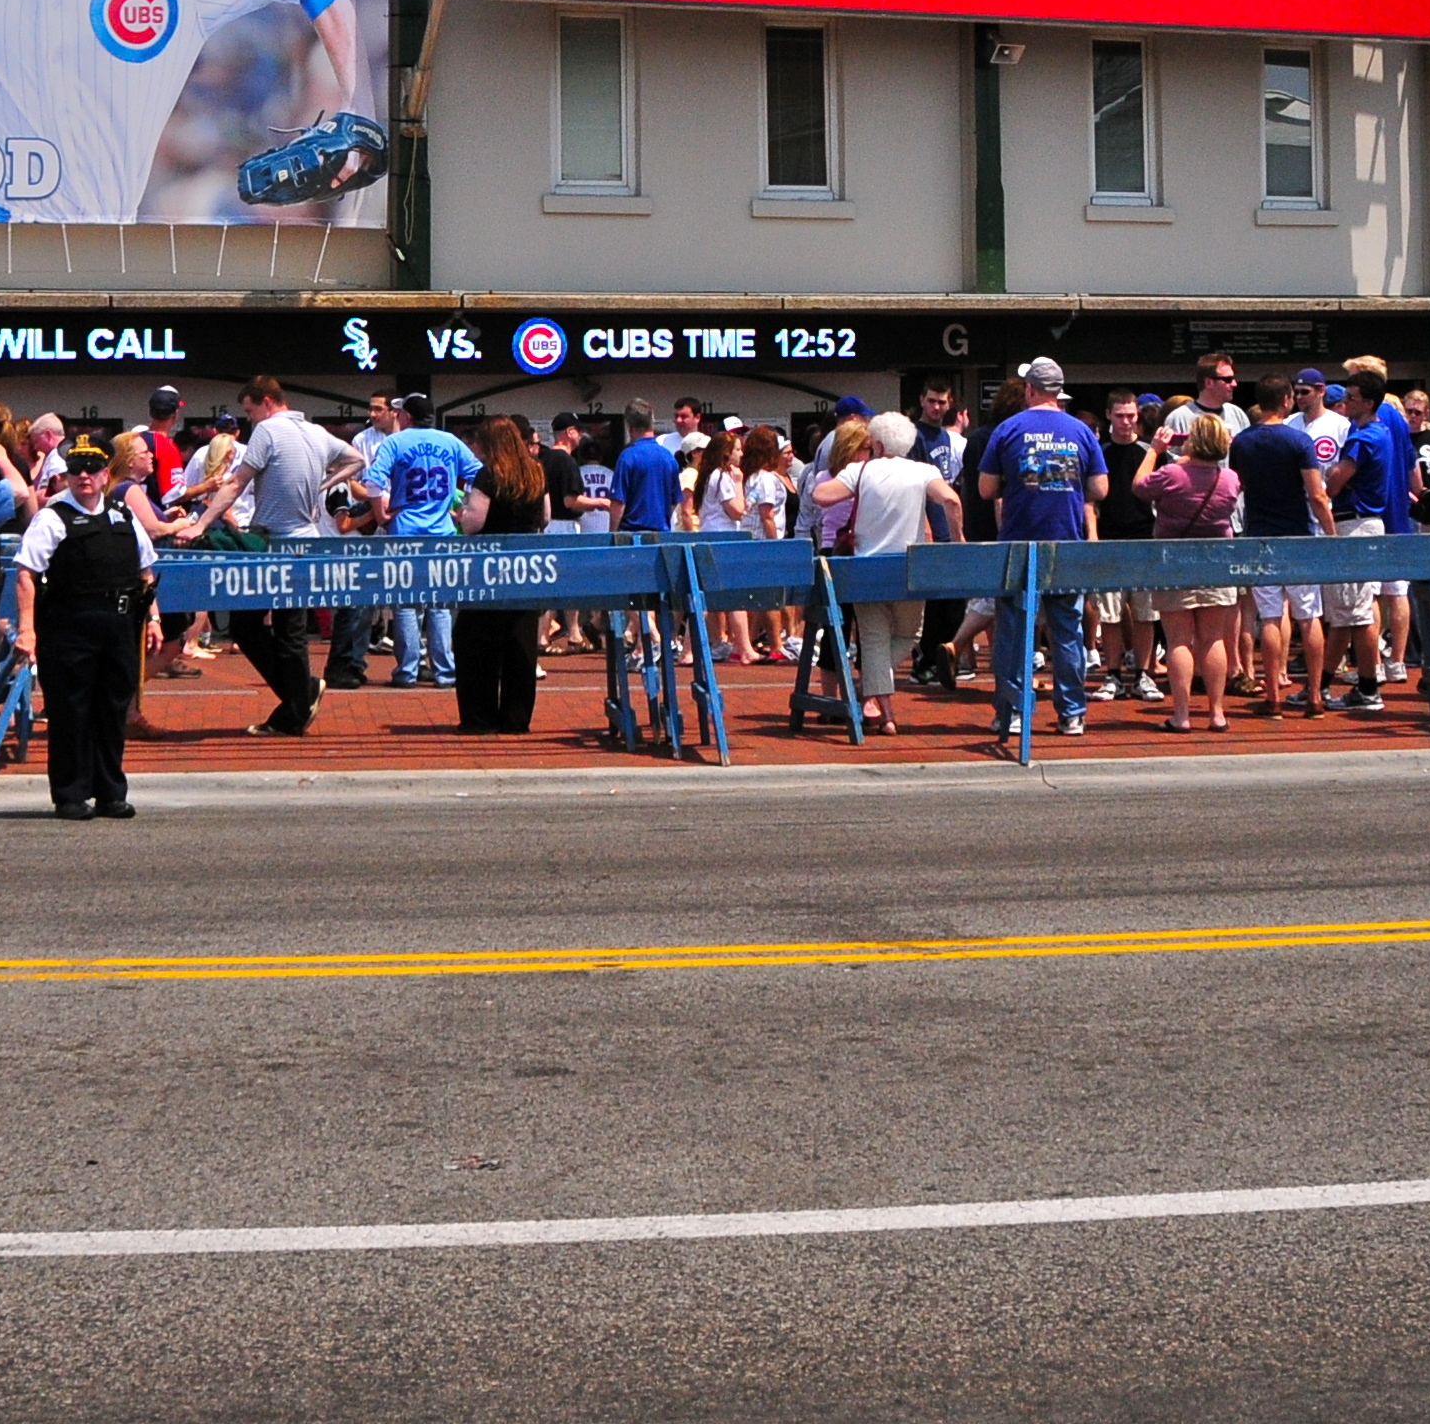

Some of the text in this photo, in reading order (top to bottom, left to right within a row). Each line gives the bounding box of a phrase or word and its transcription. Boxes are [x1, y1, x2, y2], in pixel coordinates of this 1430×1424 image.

[86, 328, 186, 360] CALL
[426, 328, 482, 360] VS.
[583, 328, 857, 359] CUBS TIME 12:52
[942, 323, 969, 356] G
[81, 406, 99, 419] 16
[470, 403, 487, 417] 13
[587, 401, 604, 415] 12
[406, 466, 450, 502] 23
[210, 564, 293, 597] POLICE
[428, 558, 473, 588] NOT
[482, 554, 558, 586] CROSS
[272, 588, 497, 610] CHICAGO POLICE DEPT
